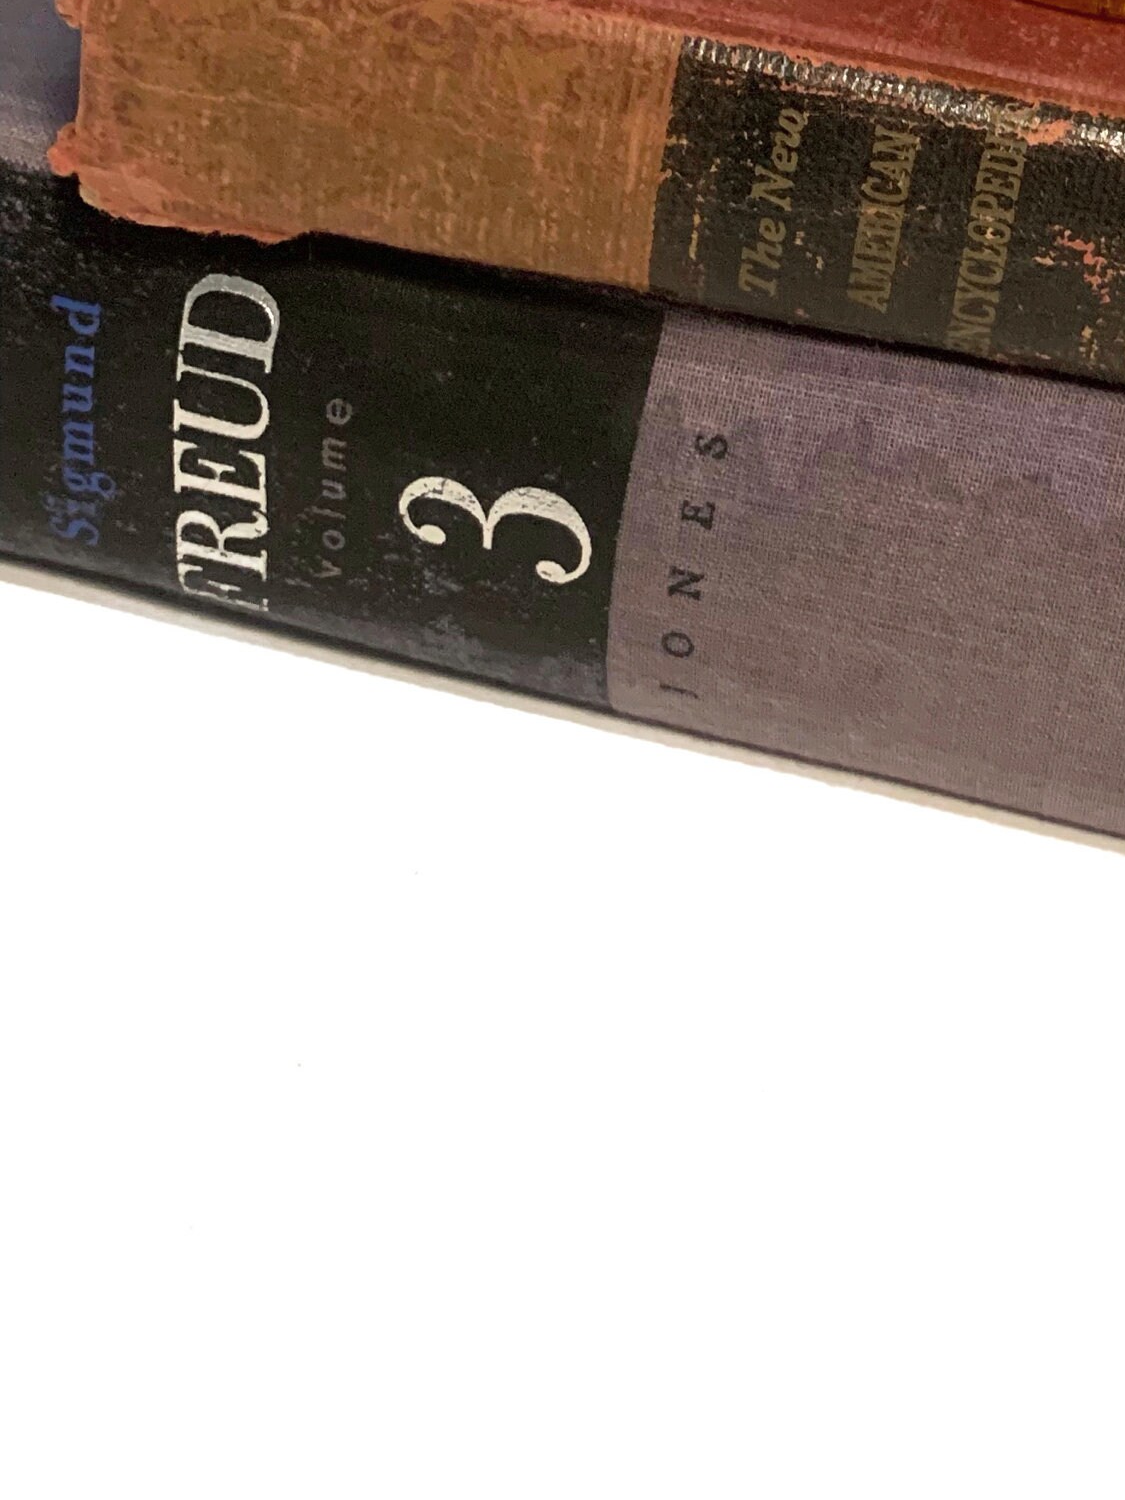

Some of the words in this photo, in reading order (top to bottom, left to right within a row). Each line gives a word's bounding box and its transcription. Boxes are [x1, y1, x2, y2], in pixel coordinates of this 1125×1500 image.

[751, 108, 809, 212] New
[847, 122, 921, 314] AMERICAN
[737, 216, 788, 297] The
[50, 294, 117, 547] Sigmund
[173, 273, 280, 612] FREUD
[314, 397, 354, 579] volume
[399, 476, 592, 586] 3
[659, 433, 729, 700] JONES
